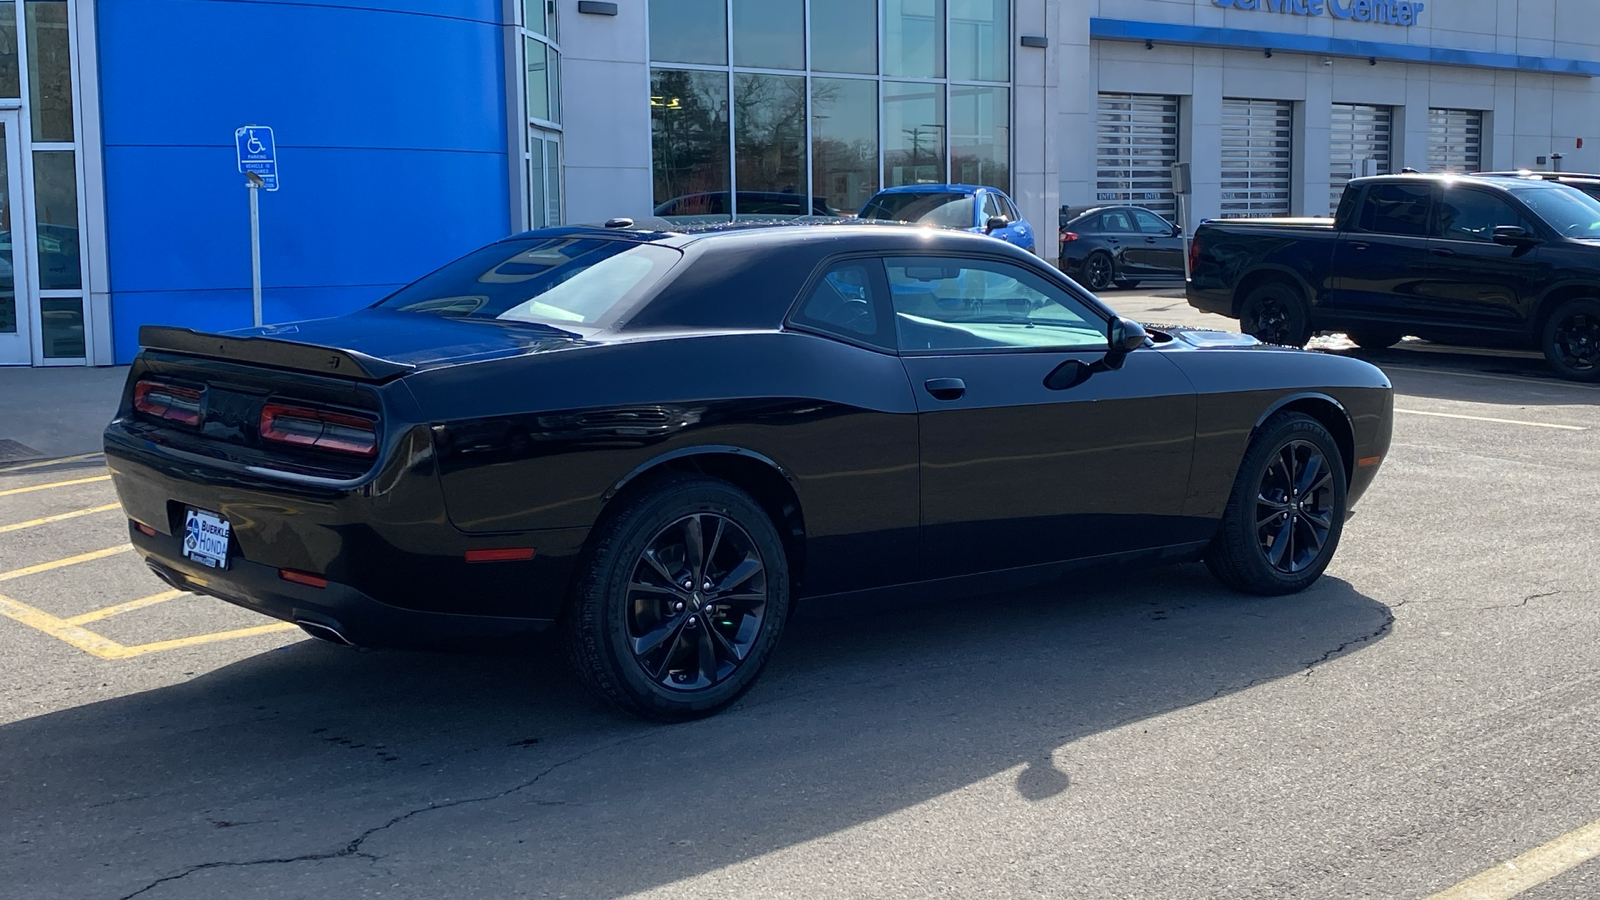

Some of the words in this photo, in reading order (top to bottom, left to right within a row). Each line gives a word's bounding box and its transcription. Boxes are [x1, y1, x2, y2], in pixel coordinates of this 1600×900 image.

[1329, 0, 1424, 26] Center
[201, 520, 229, 538] BUERKLE
[199, 532, 226, 556] HONDA
